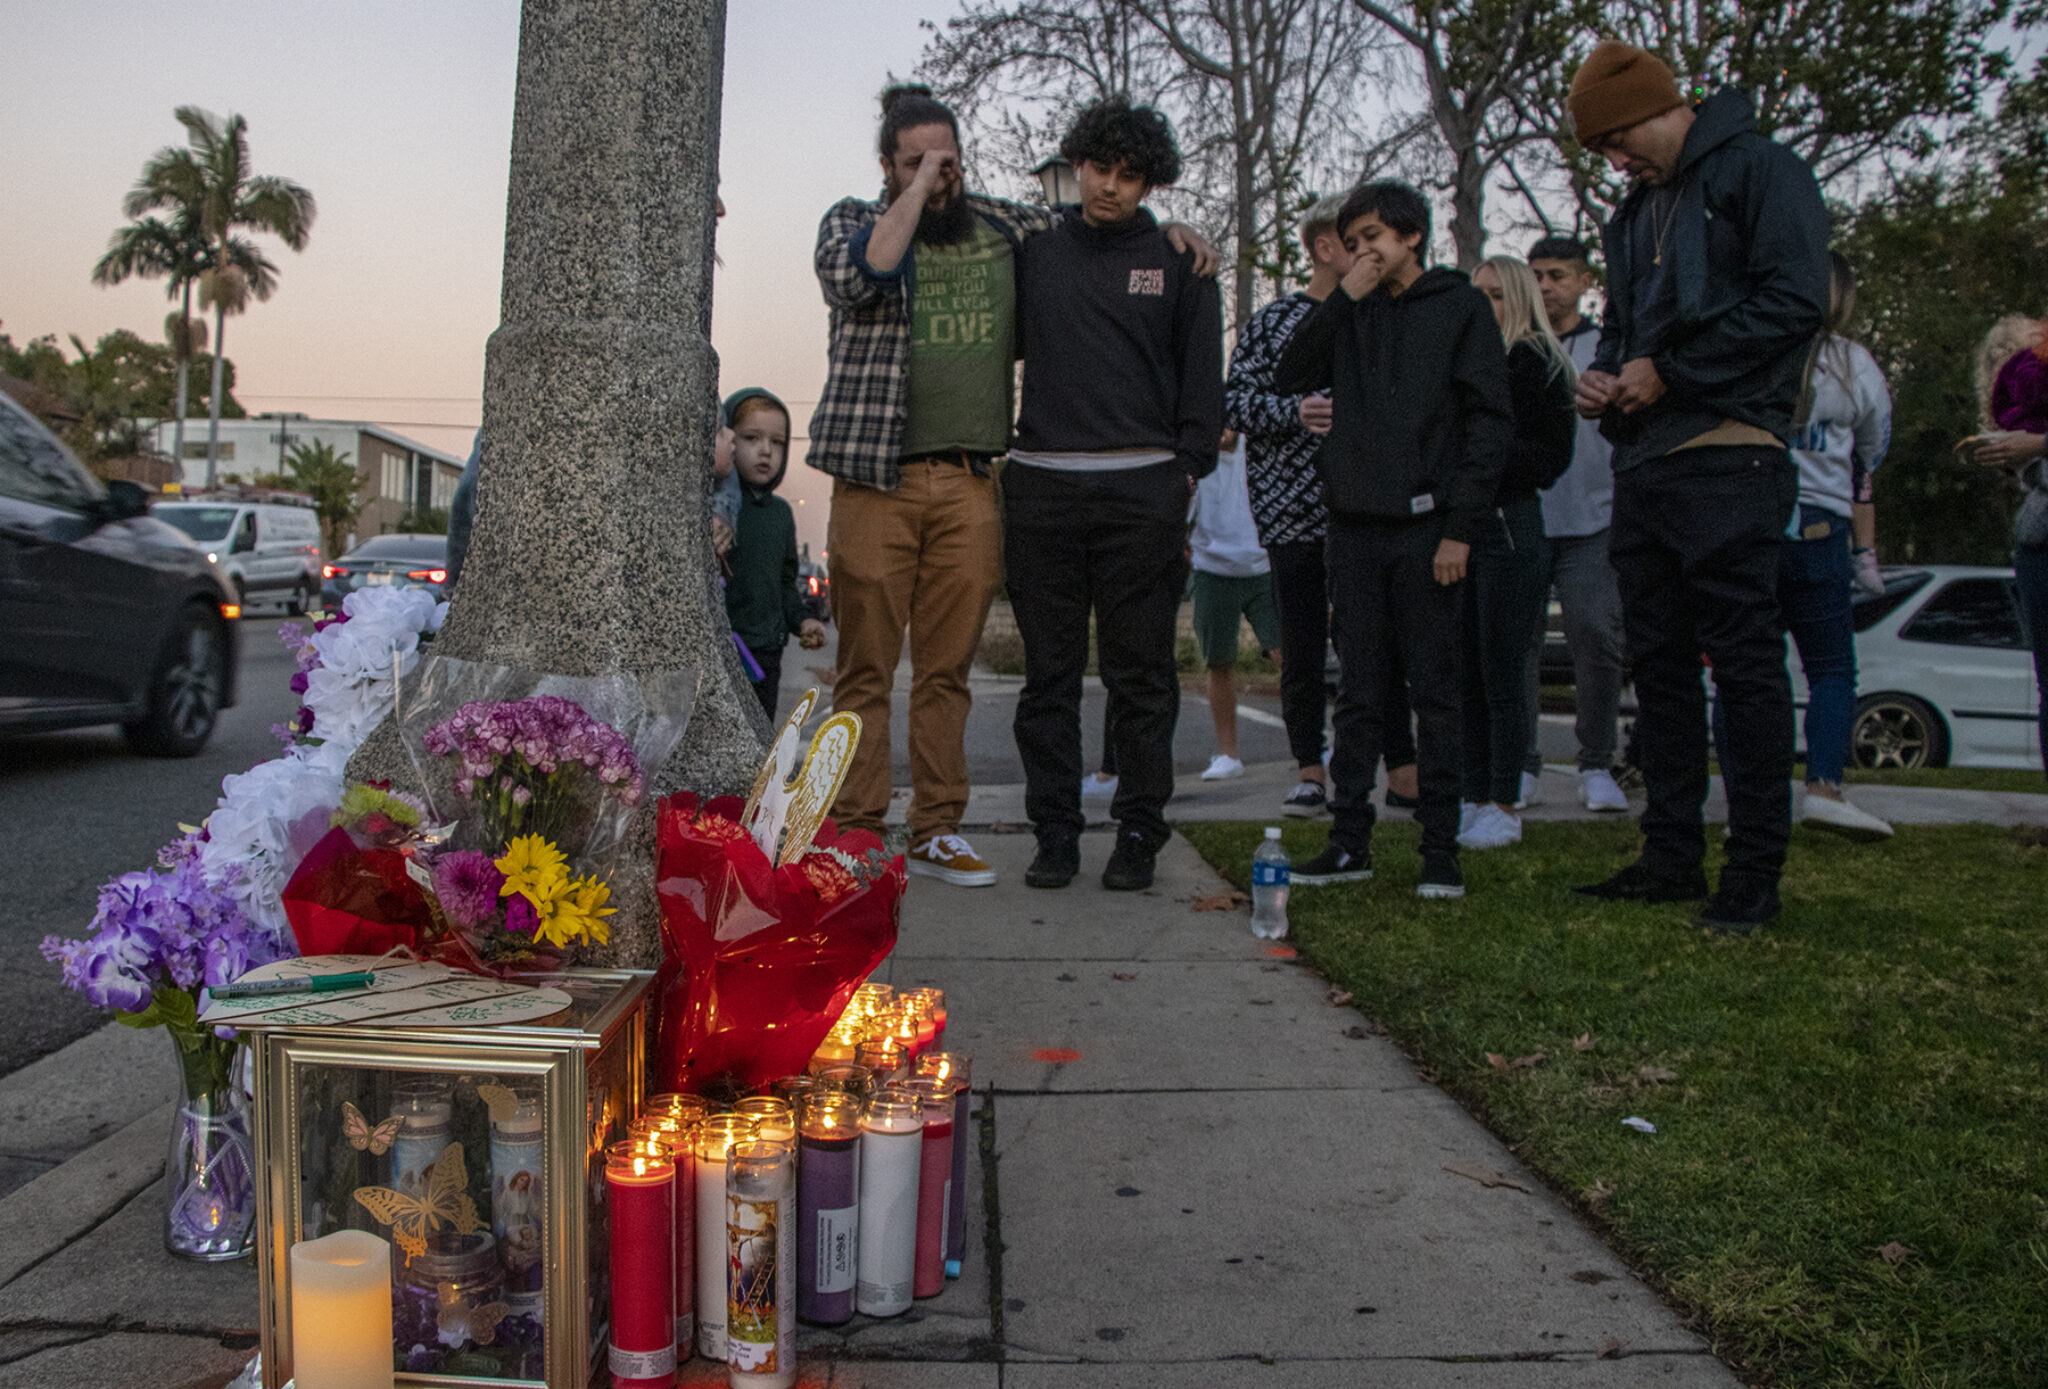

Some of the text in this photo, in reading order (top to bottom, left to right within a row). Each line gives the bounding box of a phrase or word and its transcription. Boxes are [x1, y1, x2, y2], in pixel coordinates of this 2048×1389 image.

[916, 264, 988, 281] OUGHEST
[951, 278, 986, 294] YOU
[952, 295, 991, 311] EVER
[1259, 464, 1317, 524] BALENCIA
